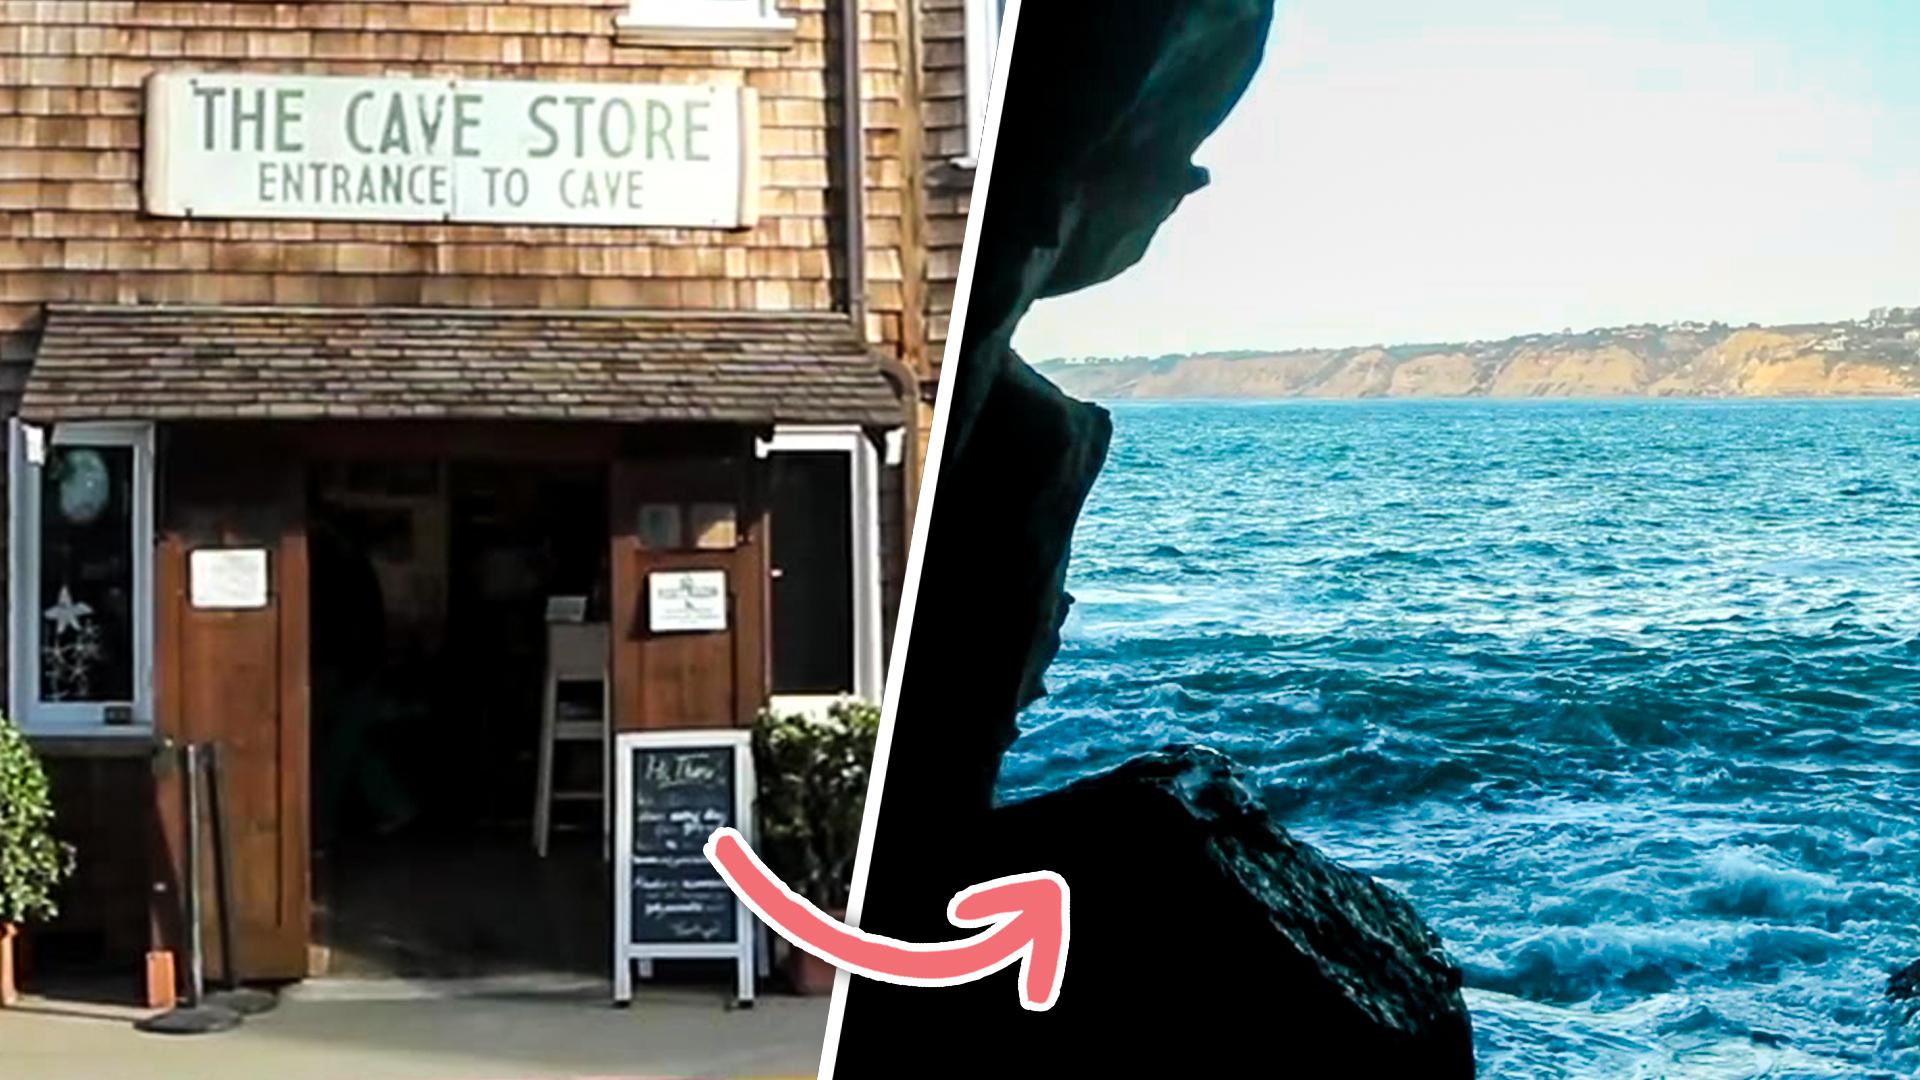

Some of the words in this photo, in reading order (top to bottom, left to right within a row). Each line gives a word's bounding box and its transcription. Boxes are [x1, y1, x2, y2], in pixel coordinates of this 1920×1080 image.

[193, 87, 304, 151] THE
[345, 90, 483, 157] CAVE
[528, 95, 710, 161] STORE
[259, 162, 447, 204] ENTRANCE
[483, 167, 529, 207] TO
[559, 169, 643, 209] CAVE
